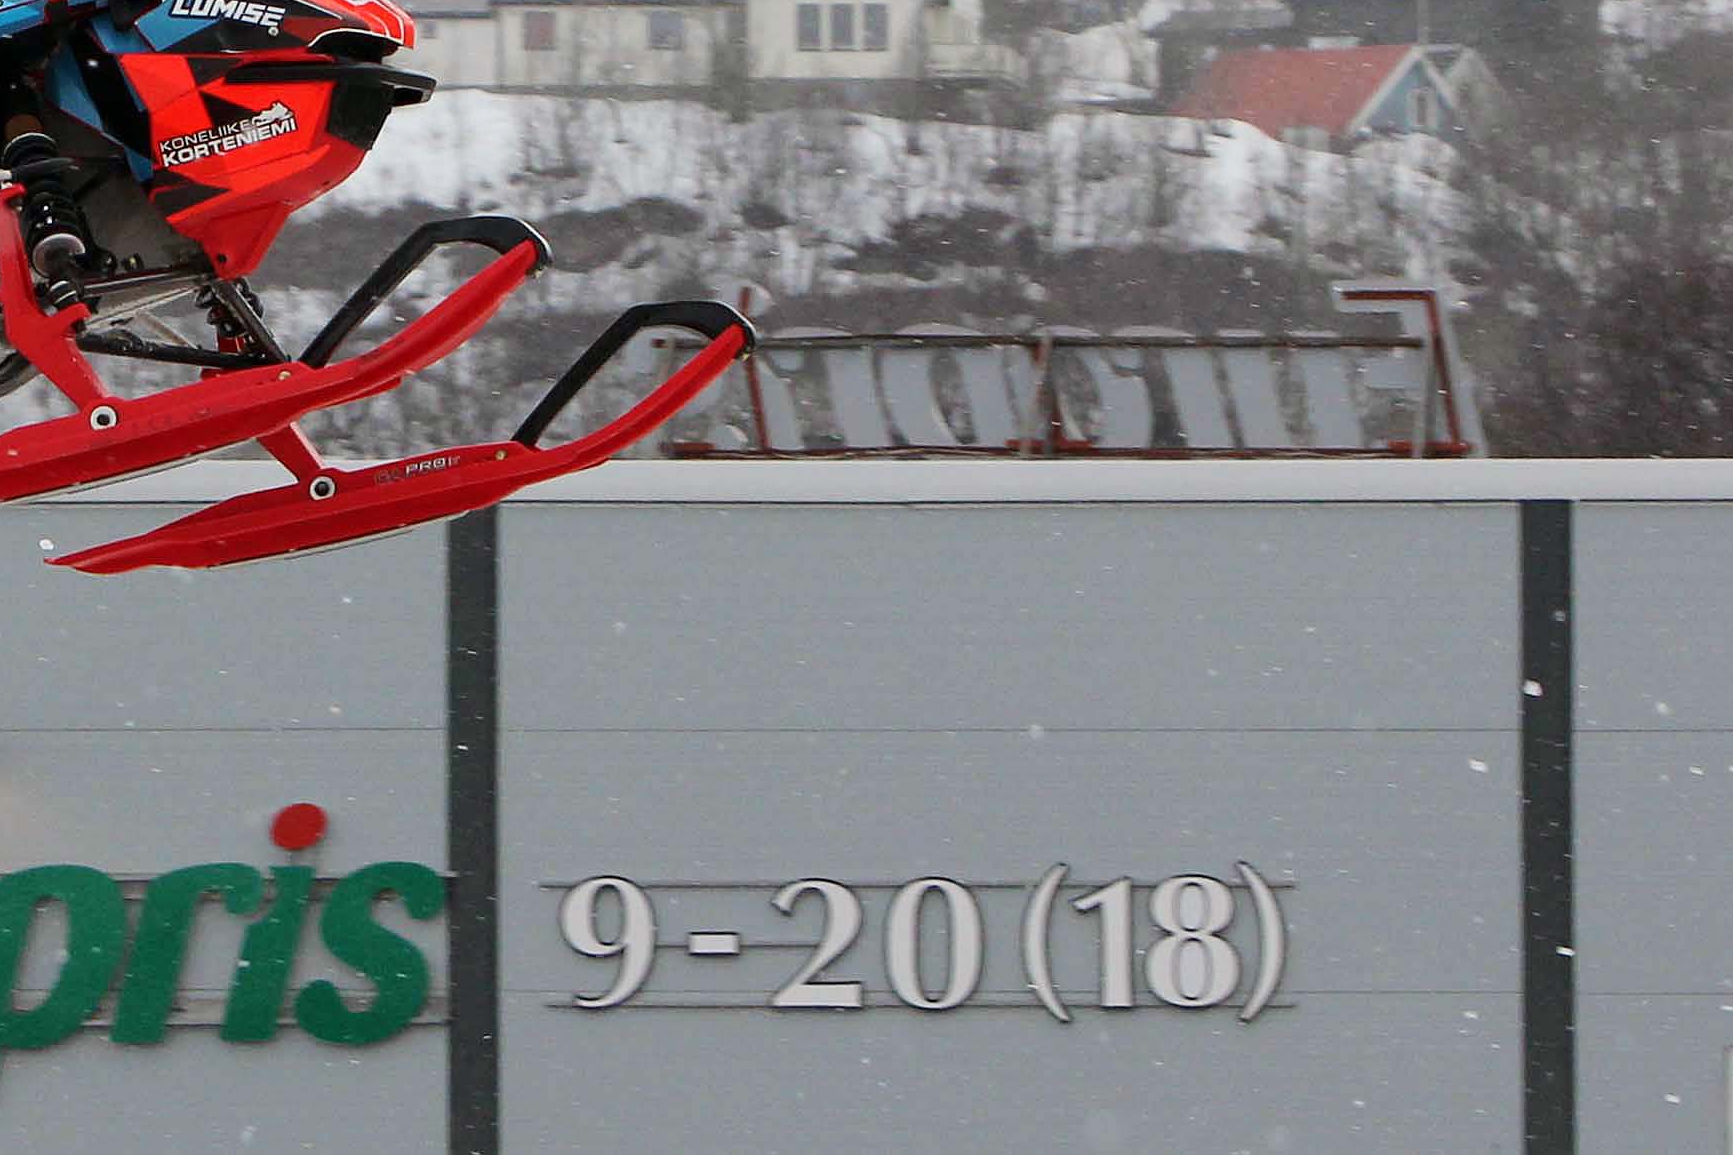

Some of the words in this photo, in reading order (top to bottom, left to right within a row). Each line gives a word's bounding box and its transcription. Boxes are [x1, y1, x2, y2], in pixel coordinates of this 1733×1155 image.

[160, 119, 254, 153] KONELIIKE
[162, 118, 297, 168] KORTENIEMI
[1020, 861, 1290, 1025] (18)
